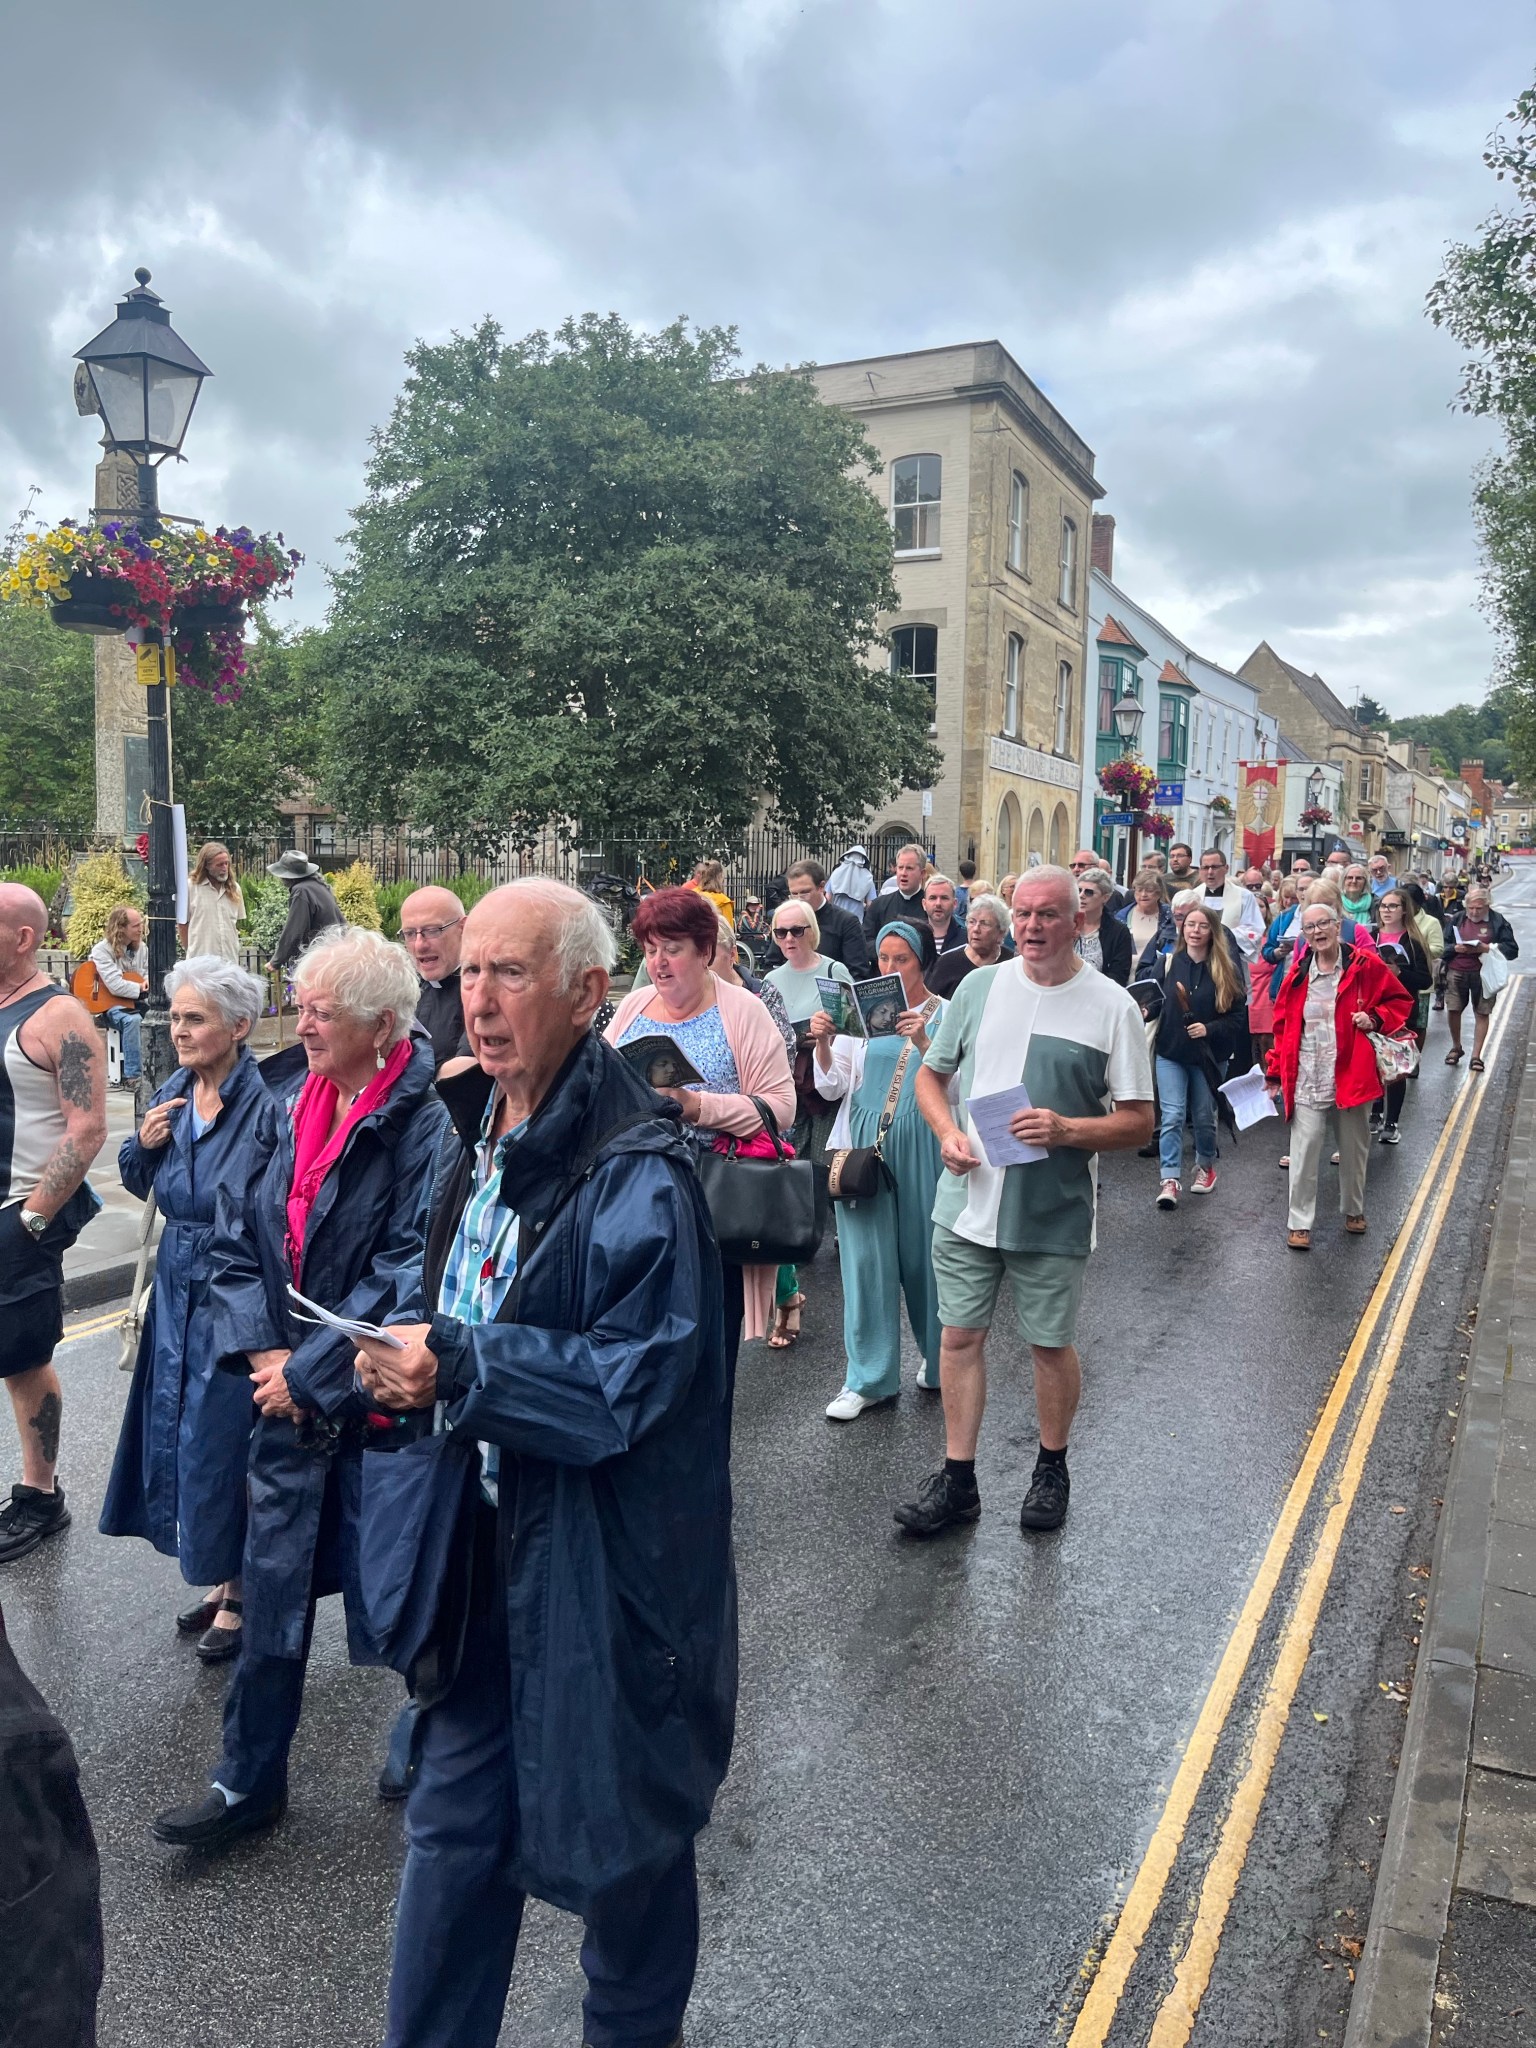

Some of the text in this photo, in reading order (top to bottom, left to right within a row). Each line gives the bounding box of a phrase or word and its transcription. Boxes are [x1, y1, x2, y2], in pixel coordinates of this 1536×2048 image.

[857, 978, 897, 992] GLASTONBURY
[858, 983, 898, 997] PILGRIMAGE
[888, 1048, 911, 1103] RIVER ISLAND
[831, 1159, 841, 1189] ISLAND
